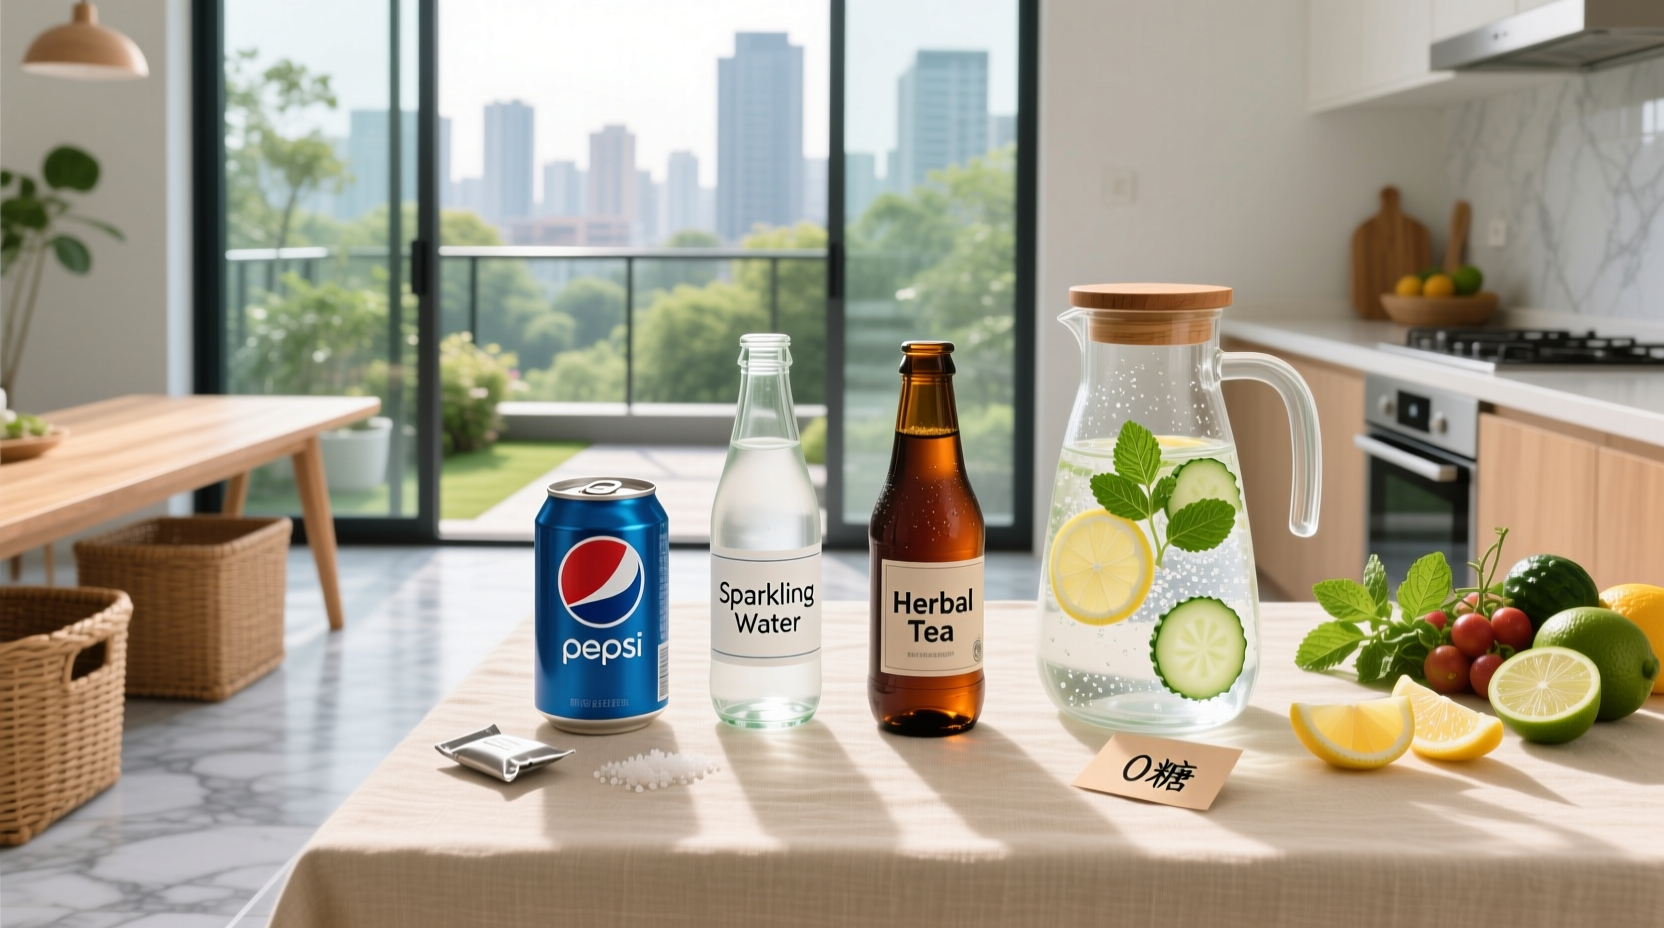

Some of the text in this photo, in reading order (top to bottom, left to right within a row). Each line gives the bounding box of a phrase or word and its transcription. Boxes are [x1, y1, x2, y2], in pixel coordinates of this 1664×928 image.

[719, 581, 815, 611] Sparkling
[893, 588, 973, 615] Herbal
[734, 612, 801, 634] Water
[907, 619, 954, 643] Tea
[562, 631, 643, 666] pepsi
